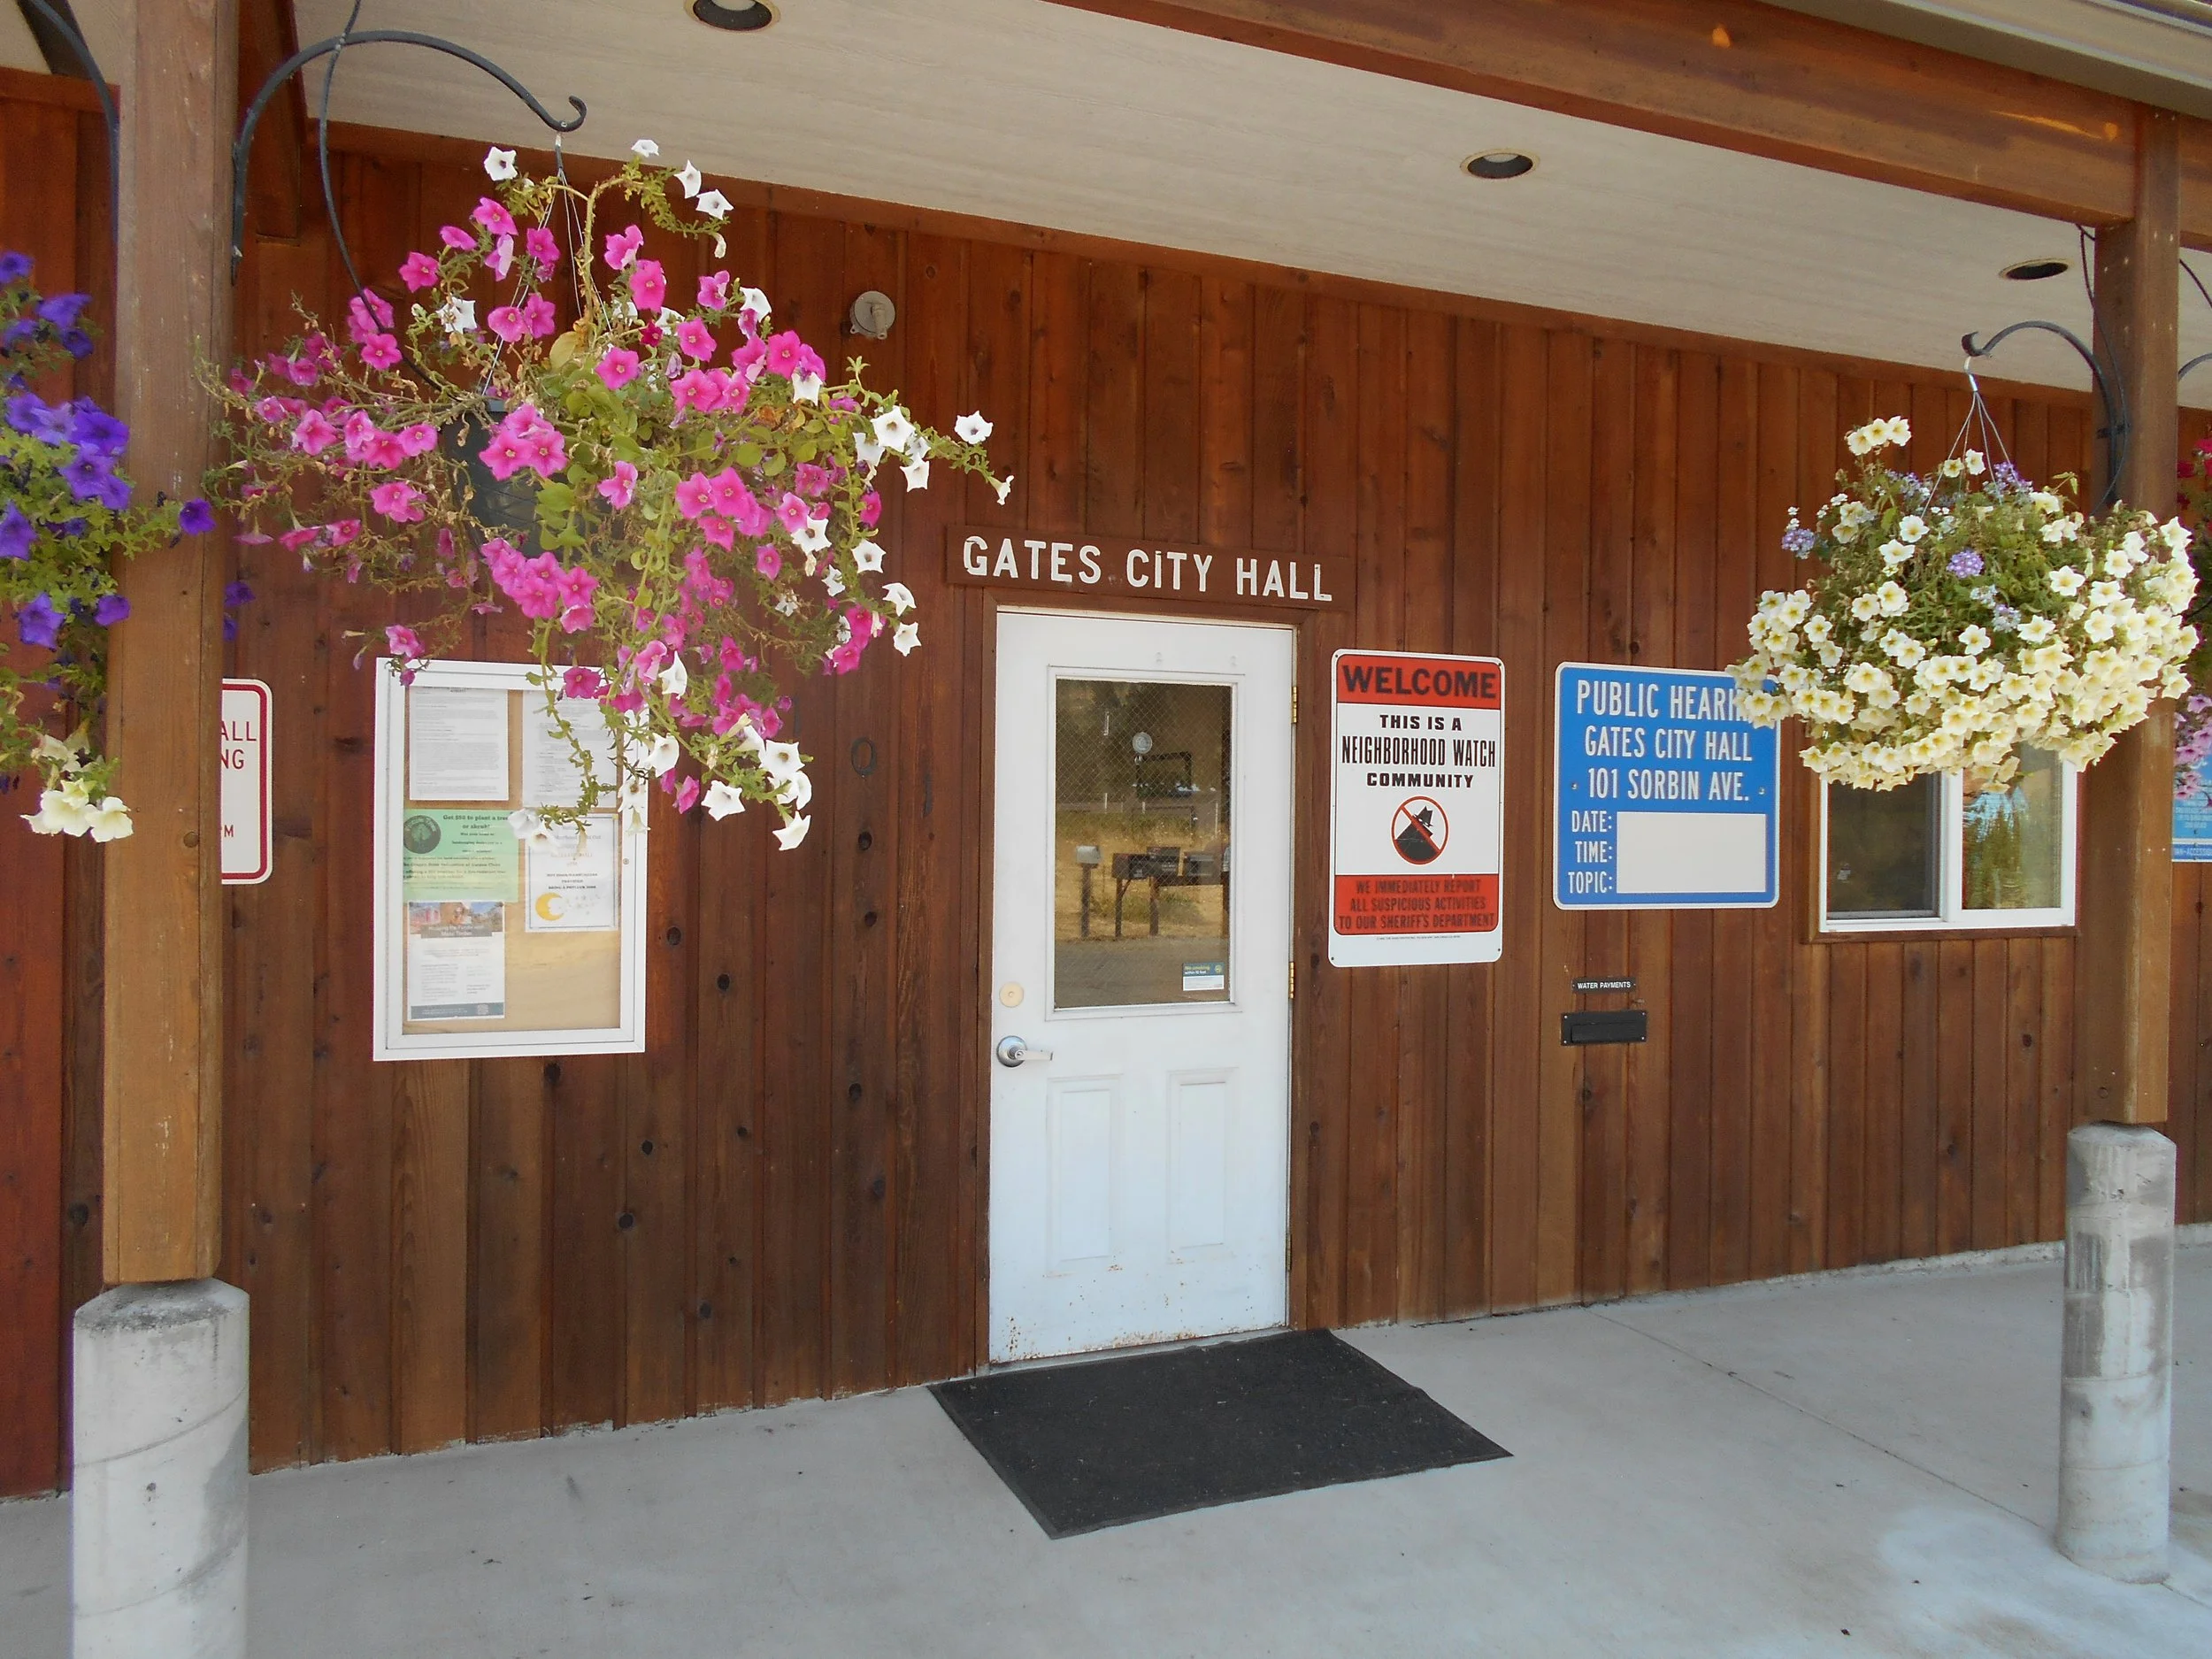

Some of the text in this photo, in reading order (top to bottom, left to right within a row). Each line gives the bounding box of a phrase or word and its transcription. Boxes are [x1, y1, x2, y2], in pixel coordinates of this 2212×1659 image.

[963, 535, 1333, 602] GATES CITY HALL
[1342, 665, 1497, 699] WELCOME
[1577, 680, 1748, 722] PUBLIC HEARI
[221, 720, 257, 741] ALL
[1379, 714, 1462, 731] THIS IS A
[1341, 735, 1496, 768] NEIGHBORHOOD WATCH
[1585, 725, 1753, 761] GATES CITY HALL
[1366, 772, 1474, 788] COMMUNITY
[1588, 767, 1749, 801] 101 SORBIN AVE.
[1571, 810, 1612, 833] DATE:
[1575, 841, 1613, 863] TIME:
[1356, 879, 1481, 894] WE IMMEDIATELY REPORT
[1568, 871, 1613, 894] TOPIC:
[1350, 896, 1486, 912] ALL SUSPICIOUS ACTIVITIES
[1339, 912, 1495, 929] TO OUR SHERIFF'S DEPARTMENT
